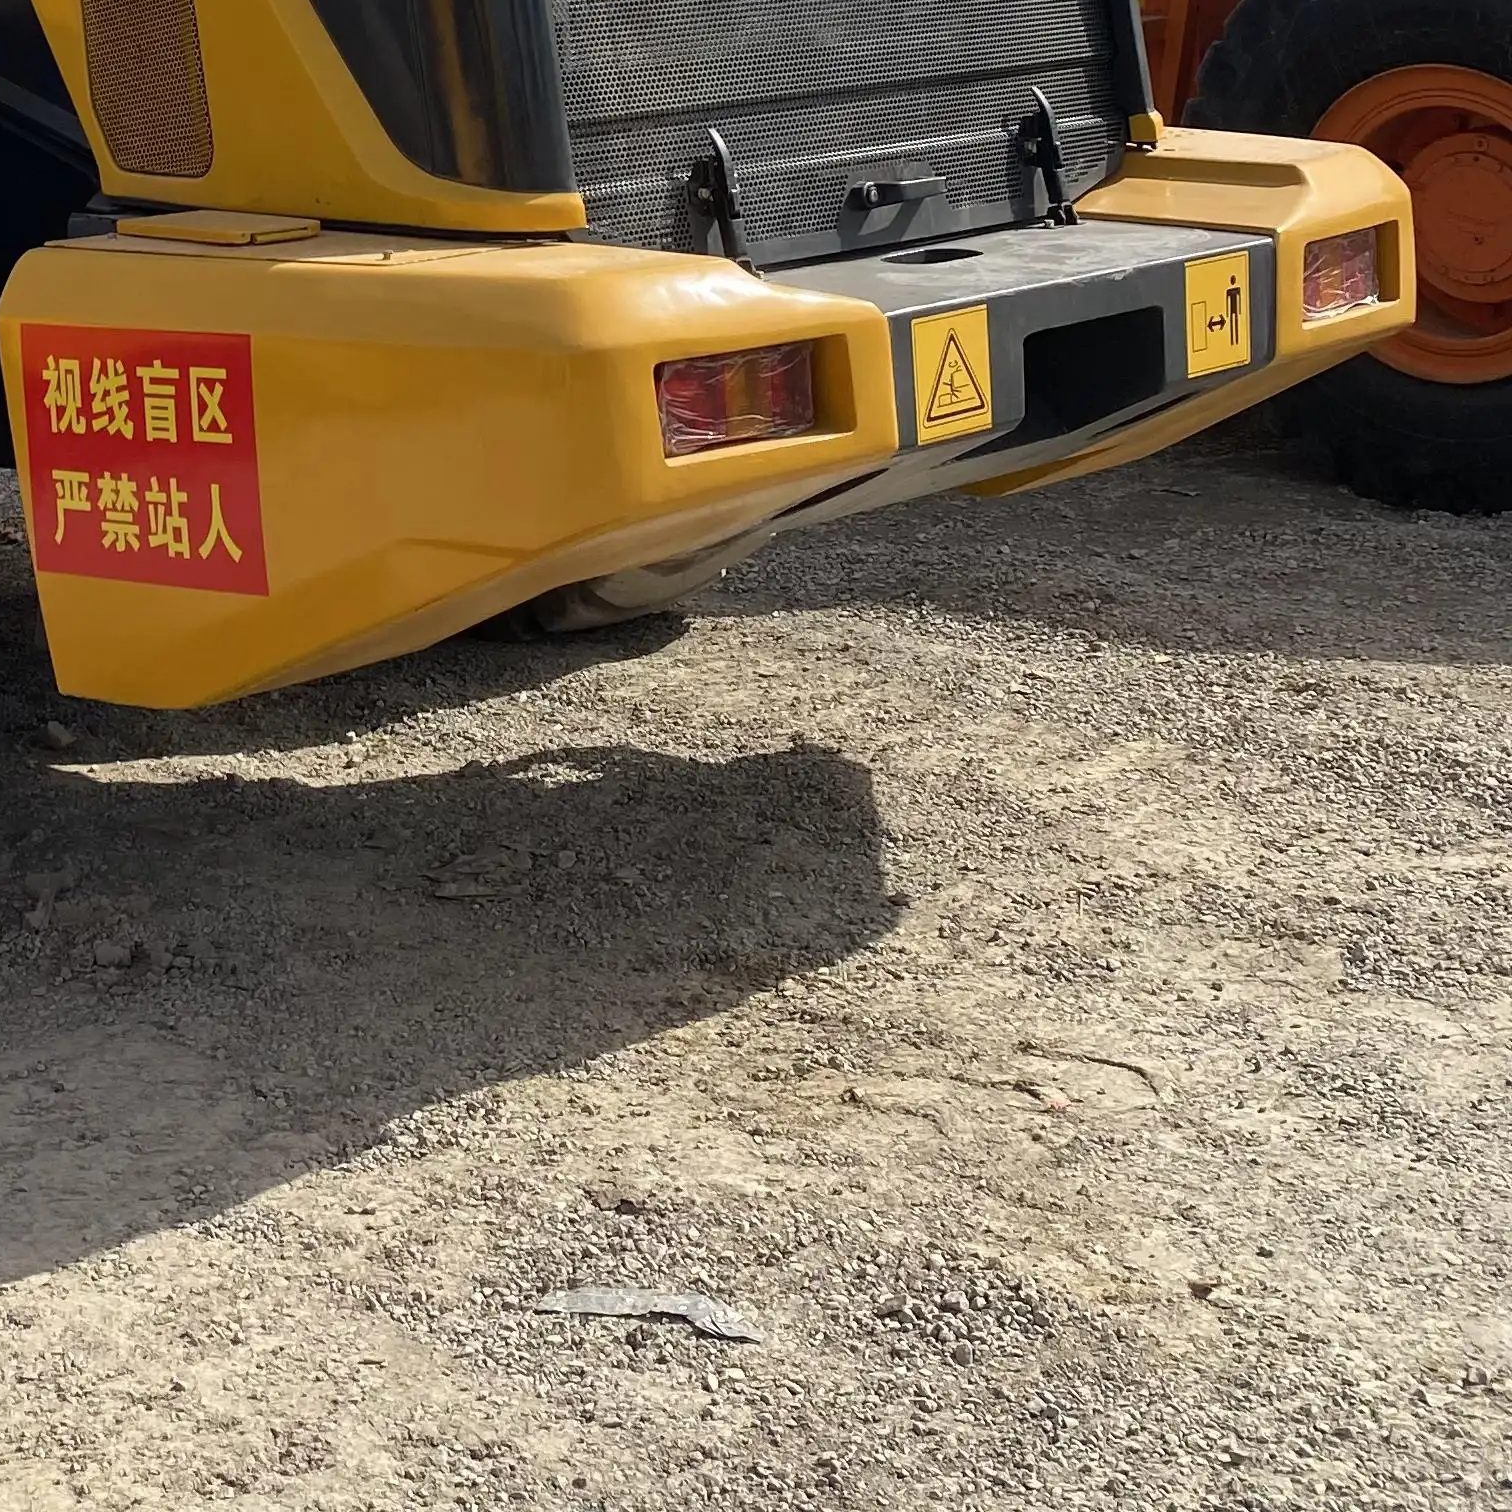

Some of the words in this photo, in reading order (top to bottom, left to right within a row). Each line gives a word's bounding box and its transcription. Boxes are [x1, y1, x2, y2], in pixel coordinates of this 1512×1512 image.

[42, 354, 233, 444] 视线盲区
[51, 469, 243, 564] 严禁站人
